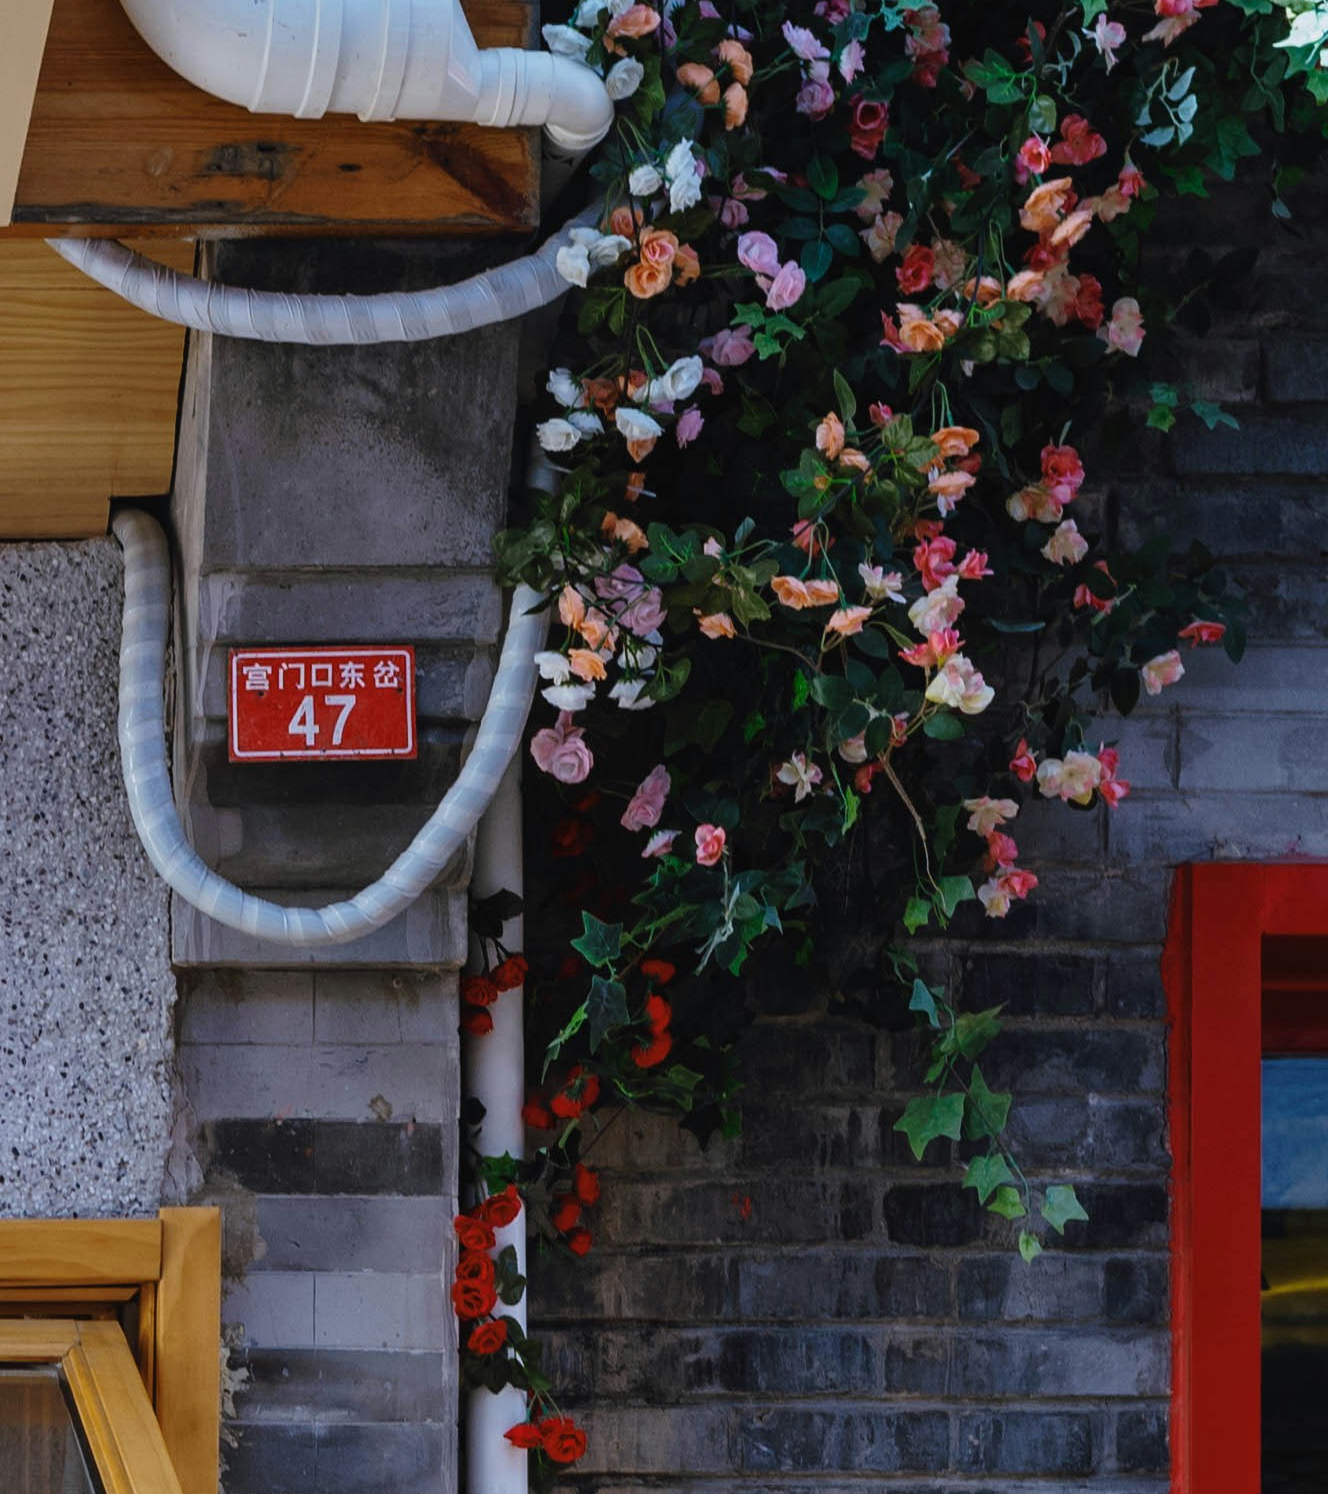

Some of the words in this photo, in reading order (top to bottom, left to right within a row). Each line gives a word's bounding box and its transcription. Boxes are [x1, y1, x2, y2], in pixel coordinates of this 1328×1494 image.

[242, 660, 400, 691] 宫门口东岔
[287, 694, 357, 746] 47
